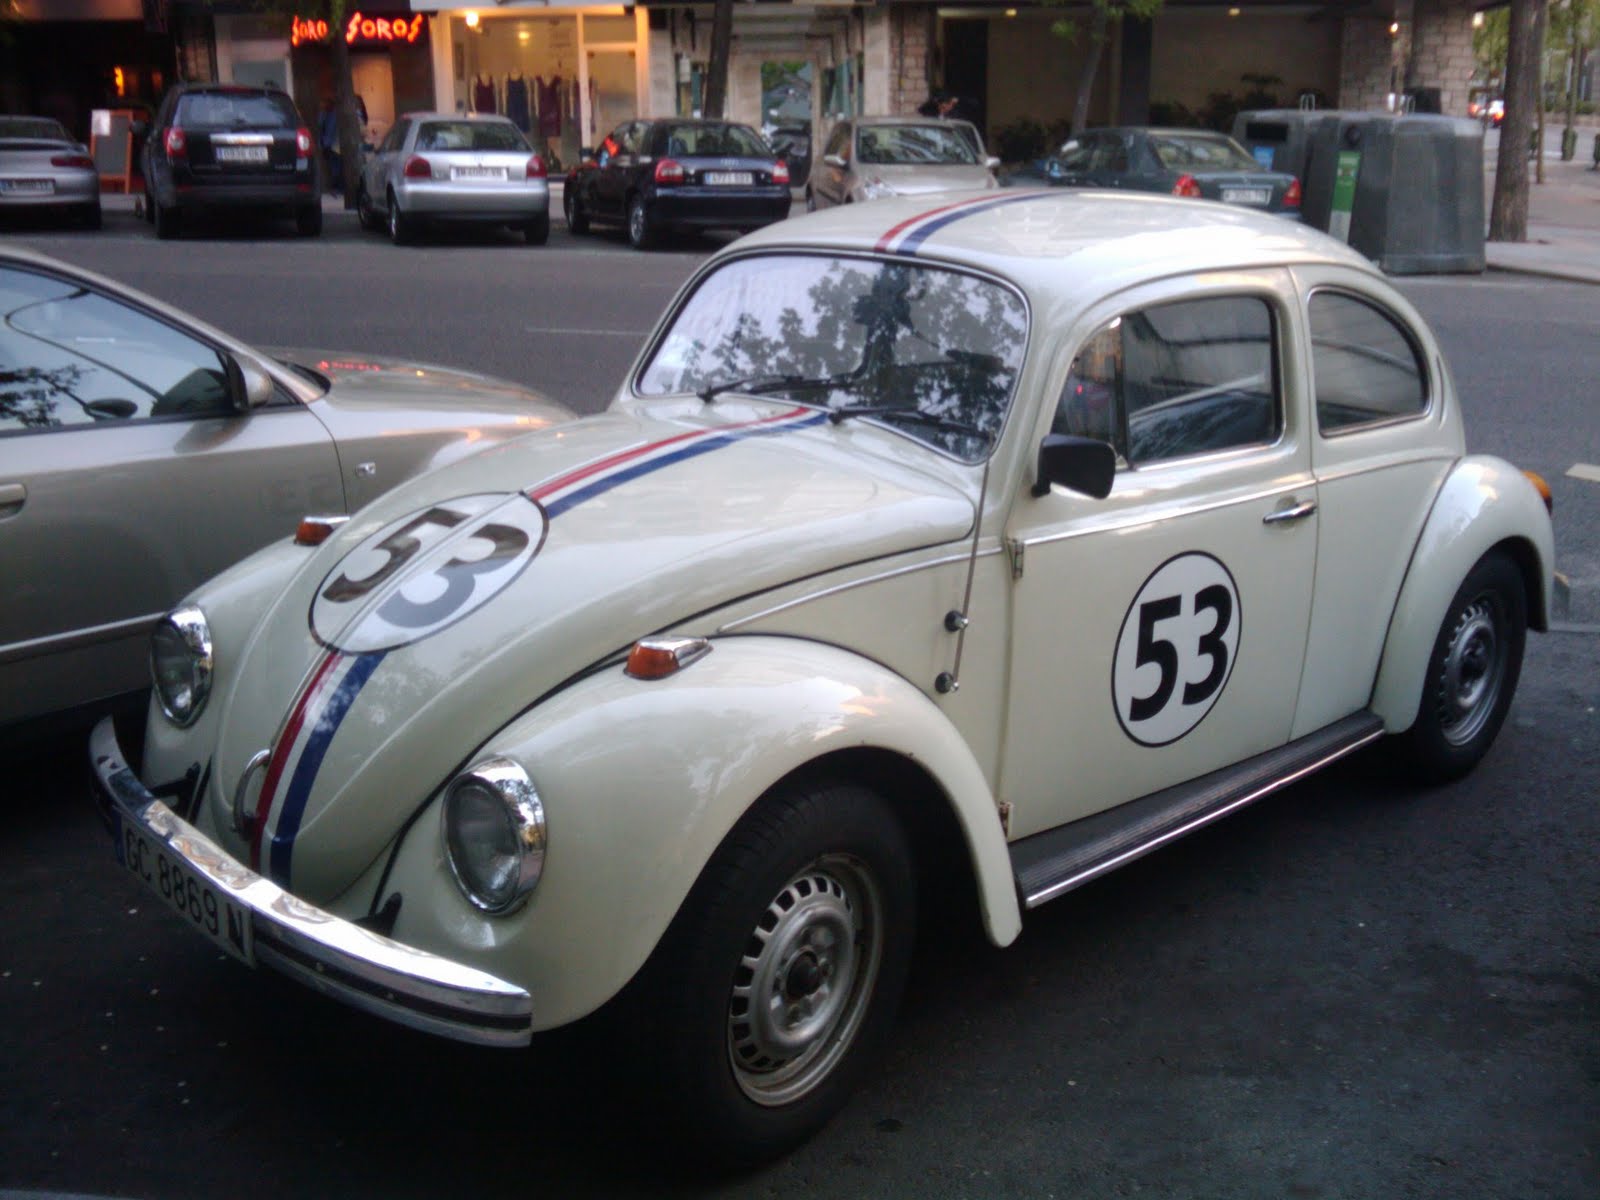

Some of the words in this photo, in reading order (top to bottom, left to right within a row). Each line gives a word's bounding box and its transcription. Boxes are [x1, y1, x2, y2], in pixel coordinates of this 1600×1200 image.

[346, 11, 423, 44] SOROS
[321, 507, 529, 628] 53
[1129, 584, 1233, 722] 53
[125, 827, 152, 883] GC
[158, 852, 219, 936] 8869
[225, 902, 247, 956] N
